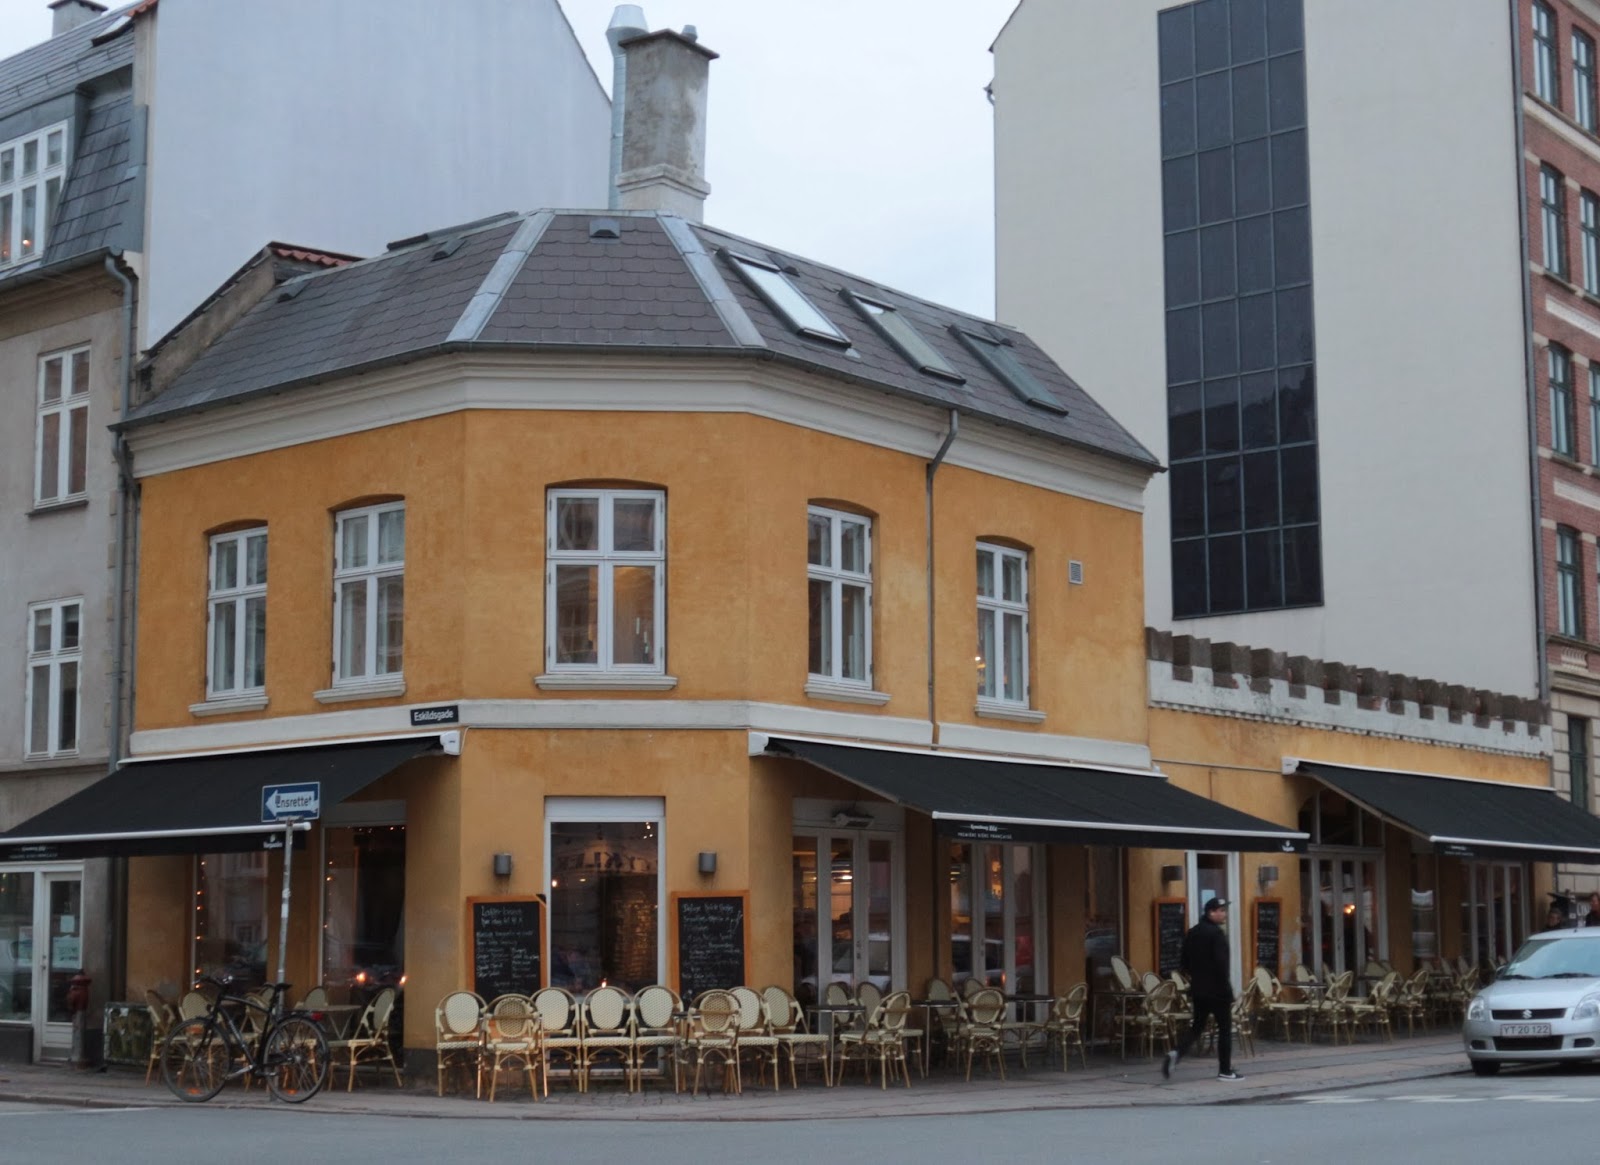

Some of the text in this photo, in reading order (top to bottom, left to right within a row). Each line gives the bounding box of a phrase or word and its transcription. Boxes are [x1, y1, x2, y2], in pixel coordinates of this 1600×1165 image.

[413, 709, 453, 721] Eskildsgade
[1504, 1025, 1549, 1034] YT 20 122
